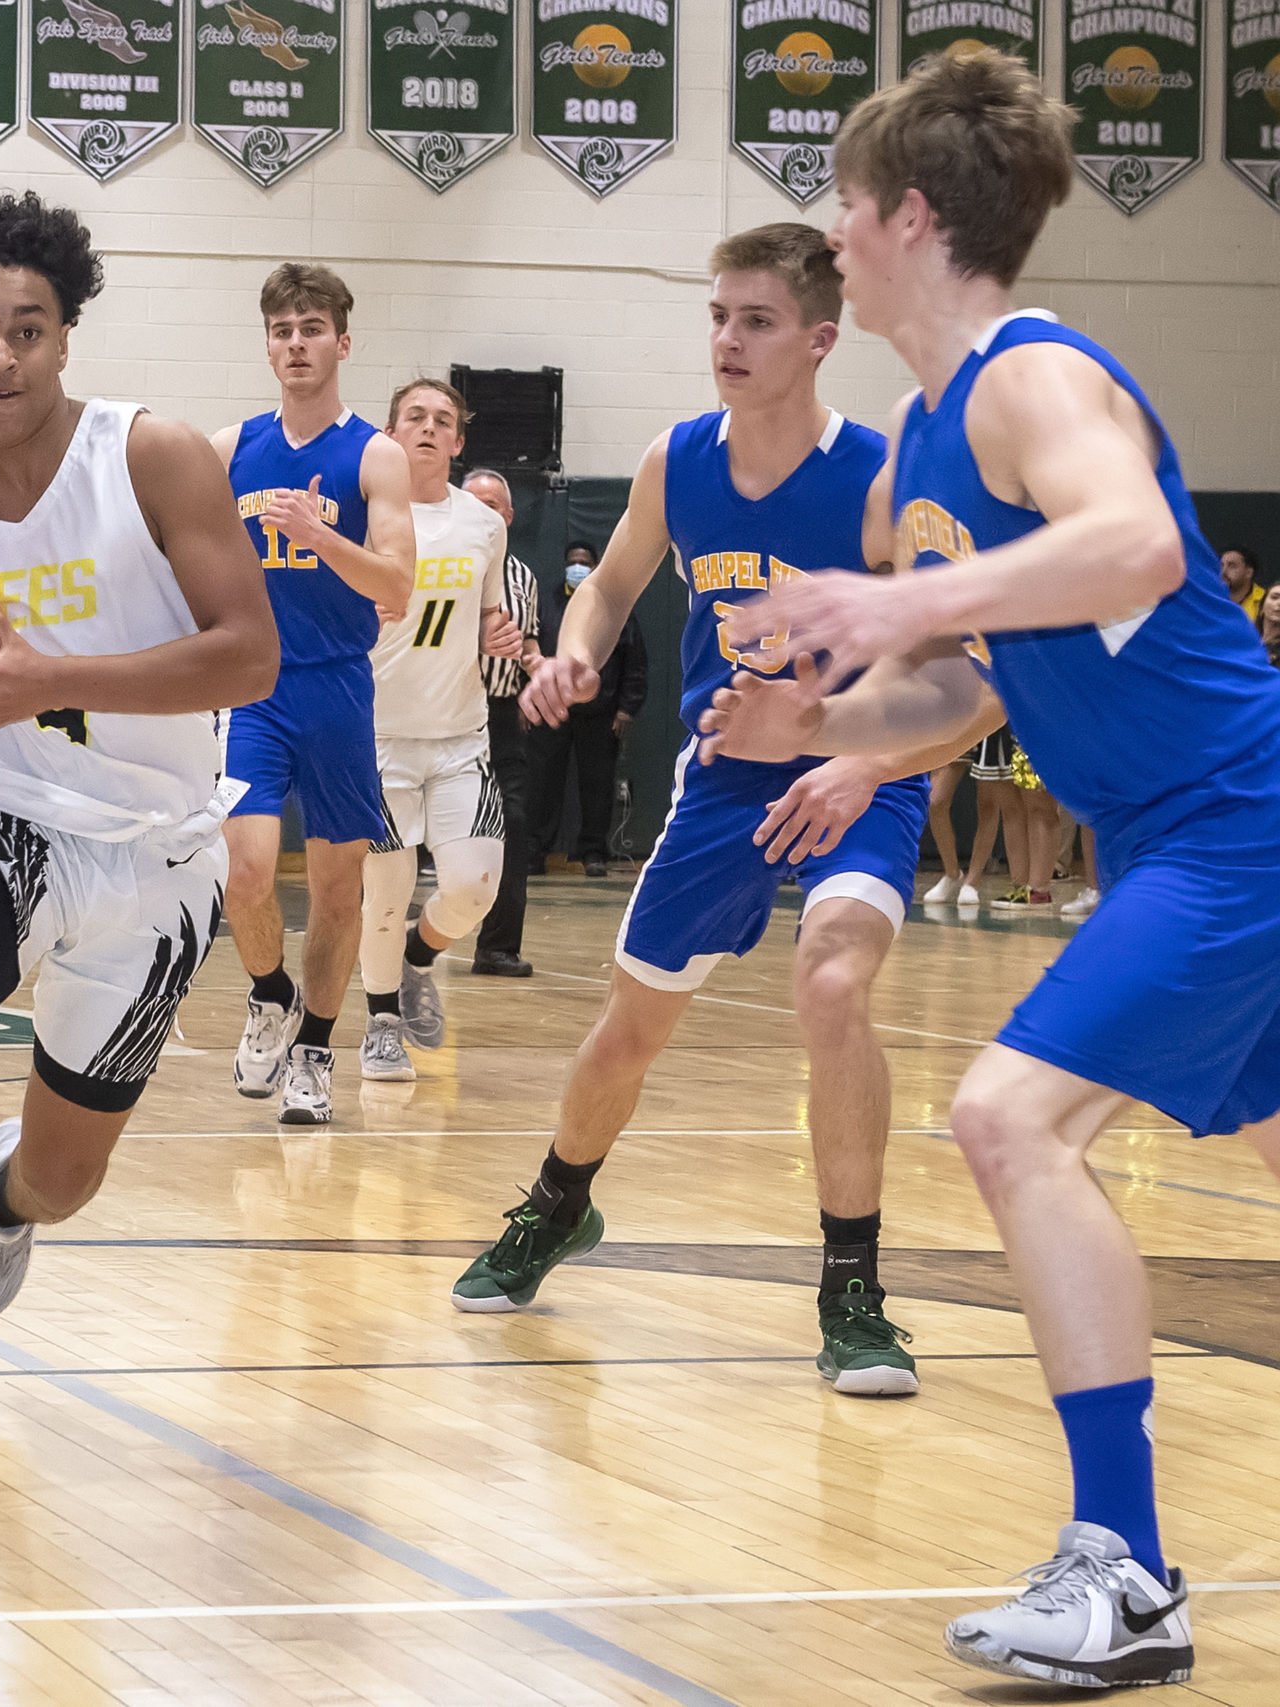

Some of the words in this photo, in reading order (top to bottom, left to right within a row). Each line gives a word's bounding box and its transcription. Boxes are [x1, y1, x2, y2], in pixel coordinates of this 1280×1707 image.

[37, 16, 74, 44] Girls
[77, 17, 128, 46] Spring
[131, 19, 173, 42] Track
[742, 0, 870, 34] CHAMPIONS
[907, 2, 1033, 41] CHAMPIONS
[1070, 8, 1196, 47] CHAMPIONS
[198, 24, 234, 51] Girls
[237, 25, 277, 45] Cross
[281, 25, 337, 54] Country
[384, 26, 435, 51] Girls
[439, 27, 498, 48] Tennis
[540, 41, 599, 72] Girls
[598, 43, 666, 68] Tennis
[743, 49, 800, 79] Girls
[799, 52, 868, 75] Tennis
[48, 72, 132, 92] DIVISION
[134, 75, 159, 93] III
[229, 80, 288, 98] CLASS
[402, 77, 479, 109] 2018
[1072, 62, 1128, 94] Girls
[1127, 65, 1193, 89] Tennis
[80, 93, 127, 111] 2006
[243, 101, 290, 118] 2004
[564, 98, 637, 124] 2008
[768, 108, 839, 134] 2007
[1098, 121, 1162, 146] 2001
[237, 488, 339, 526] CHAPLD
[415, 557, 473, 590] EES
[411, 598, 456, 649] 11
